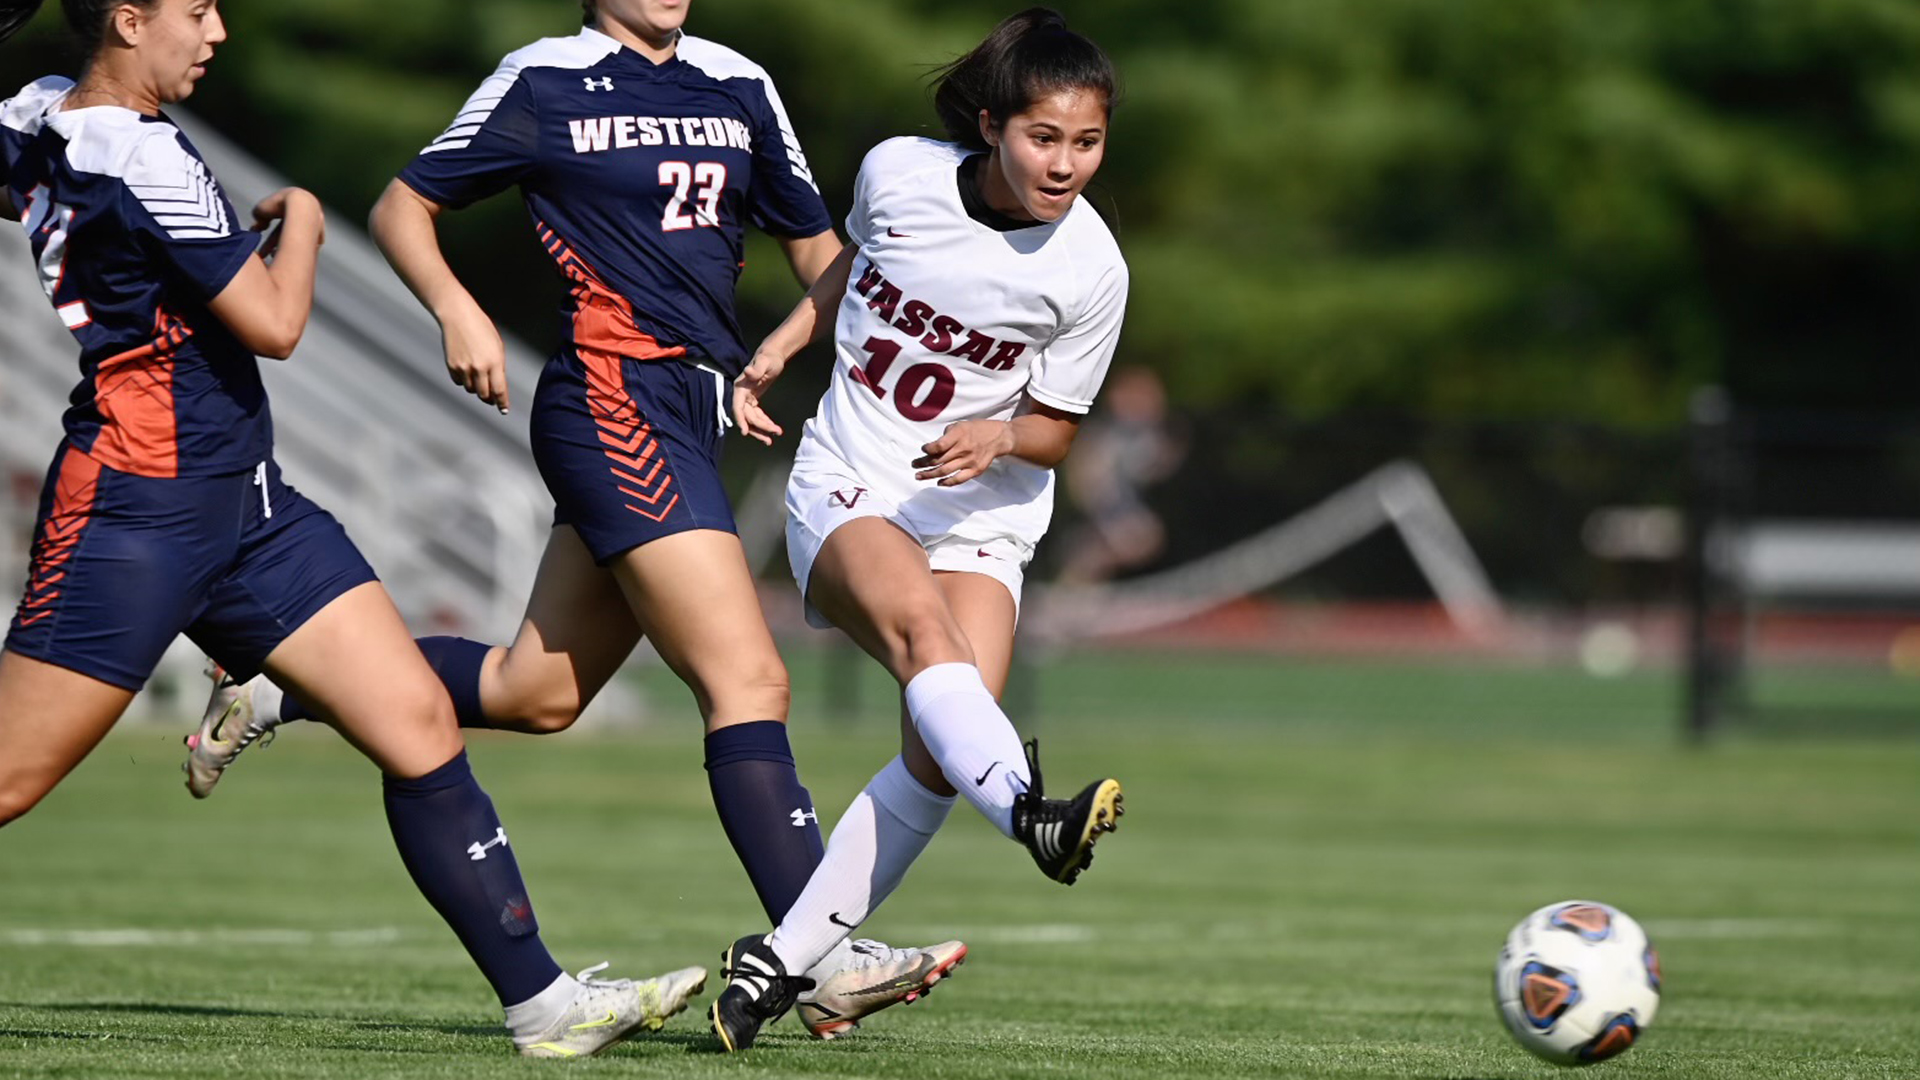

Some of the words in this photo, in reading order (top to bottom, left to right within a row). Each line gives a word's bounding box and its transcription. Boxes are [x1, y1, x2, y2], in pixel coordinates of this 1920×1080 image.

[658, 161, 726, 232] 23
[855, 262, 1027, 371] VASSAR
[848, 336, 956, 422] 10
